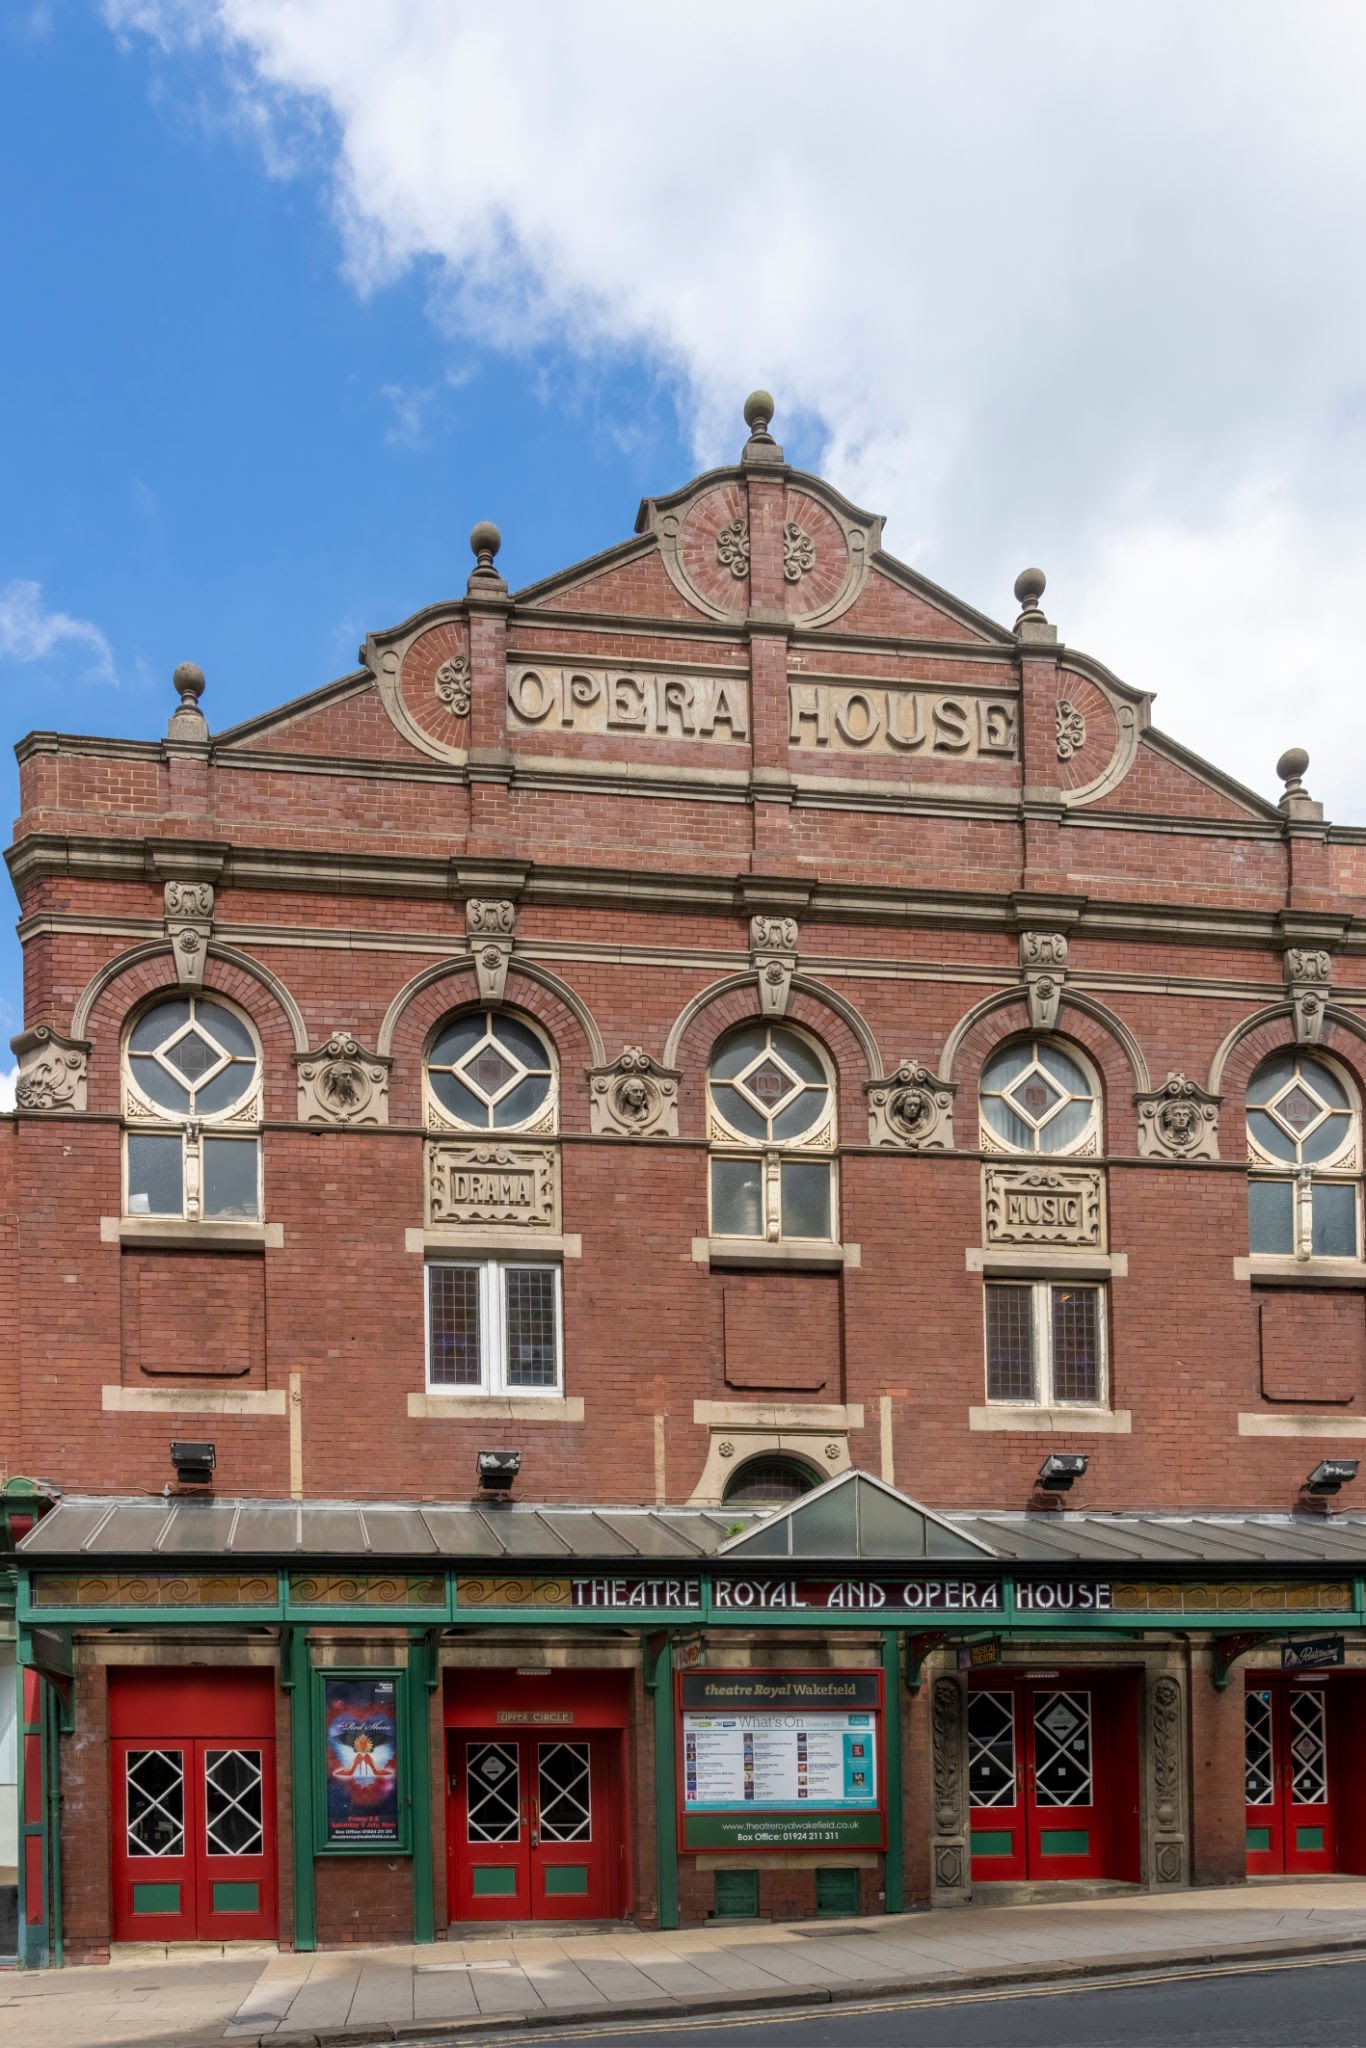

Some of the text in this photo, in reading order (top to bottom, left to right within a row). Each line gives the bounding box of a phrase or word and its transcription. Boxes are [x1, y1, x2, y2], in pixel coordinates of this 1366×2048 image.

[508, 666, 1016, 754] OPERA HOUSE
[454, 1174, 530, 1204] DRAMA
[1007, 1196, 1077, 1226] MUSIC
[573, 1580, 1111, 1609] THEATRE ROYAL AND OPERA HOUSE
[705, 1683, 857, 1699] theatre Royal Wakefield
[501, 1712, 568, 1722] UPPER CIRCLE
[738, 1715, 782, 1728] What's
[784, 1715, 804, 1728] On
[722, 1822, 859, 1831] www.theatreroyalwakefield.co.uk
[737, 1832, 839, 1841] Box Office: 01924 211 311
